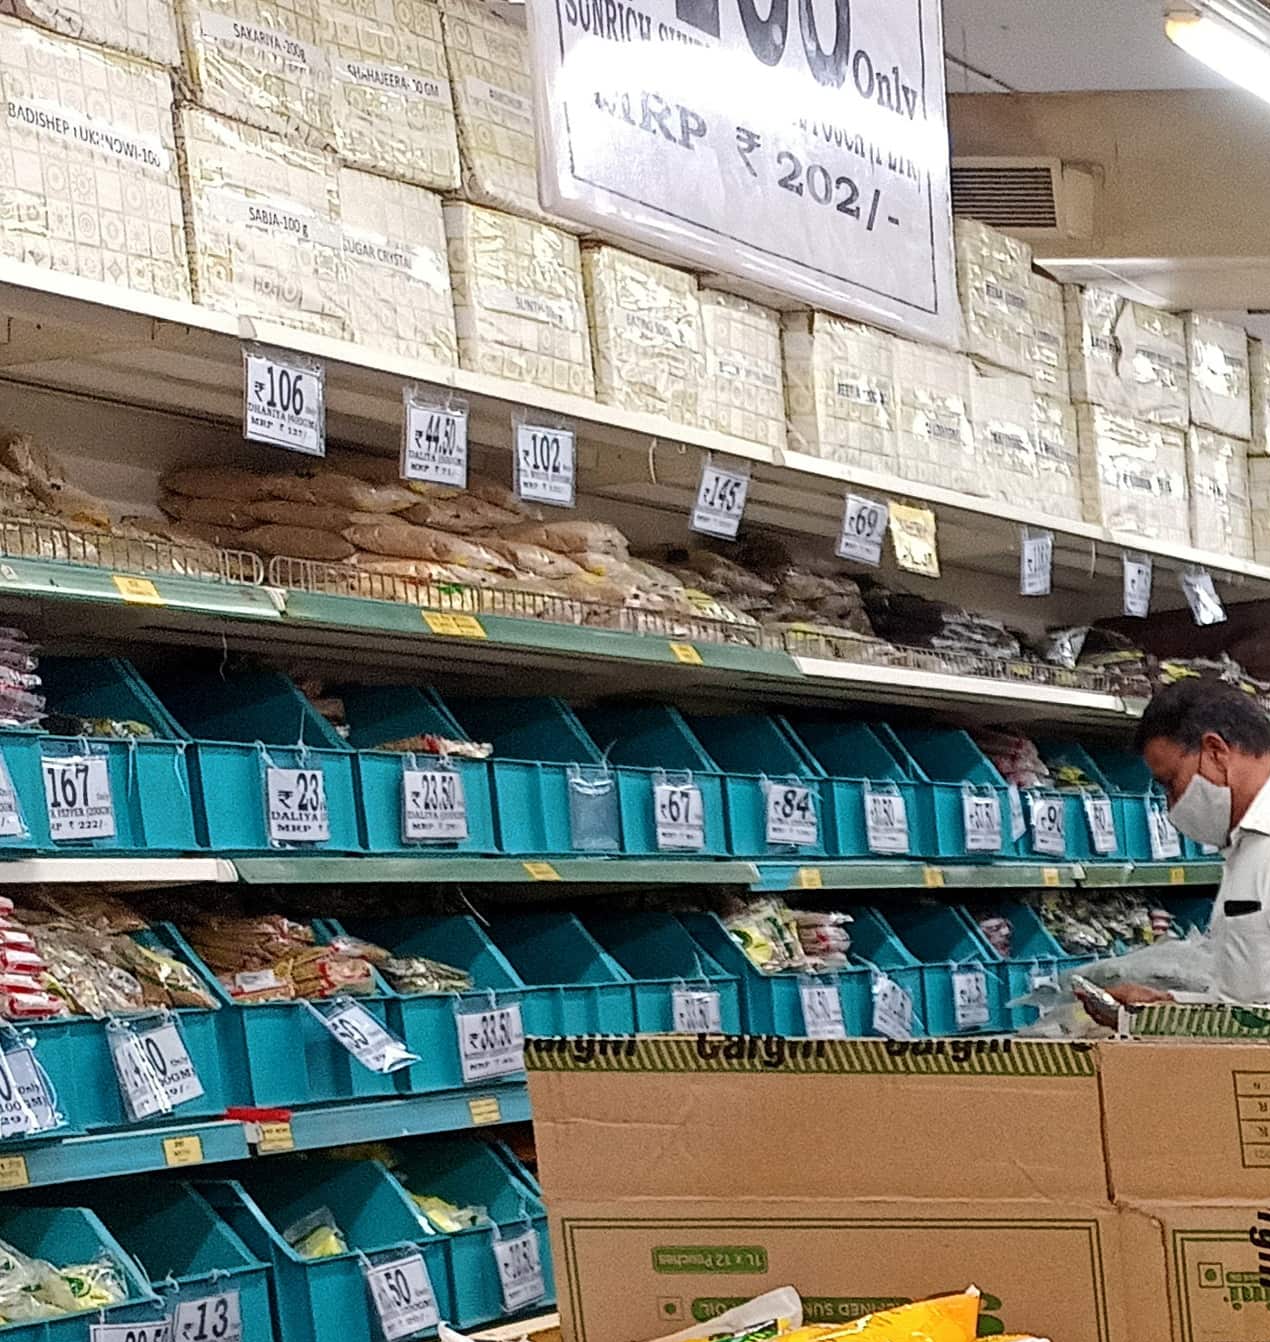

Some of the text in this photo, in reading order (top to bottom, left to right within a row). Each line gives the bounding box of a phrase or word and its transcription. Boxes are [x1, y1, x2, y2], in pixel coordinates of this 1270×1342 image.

[852, 49, 919, 120] Only
[7, 101, 71, 136] BADISHEP
[776, 150, 900, 232] 202/-
[47, 764, 91, 809] 167
[271, 811, 319, 822] DALIYA
[277, 823, 312, 833] MRP
